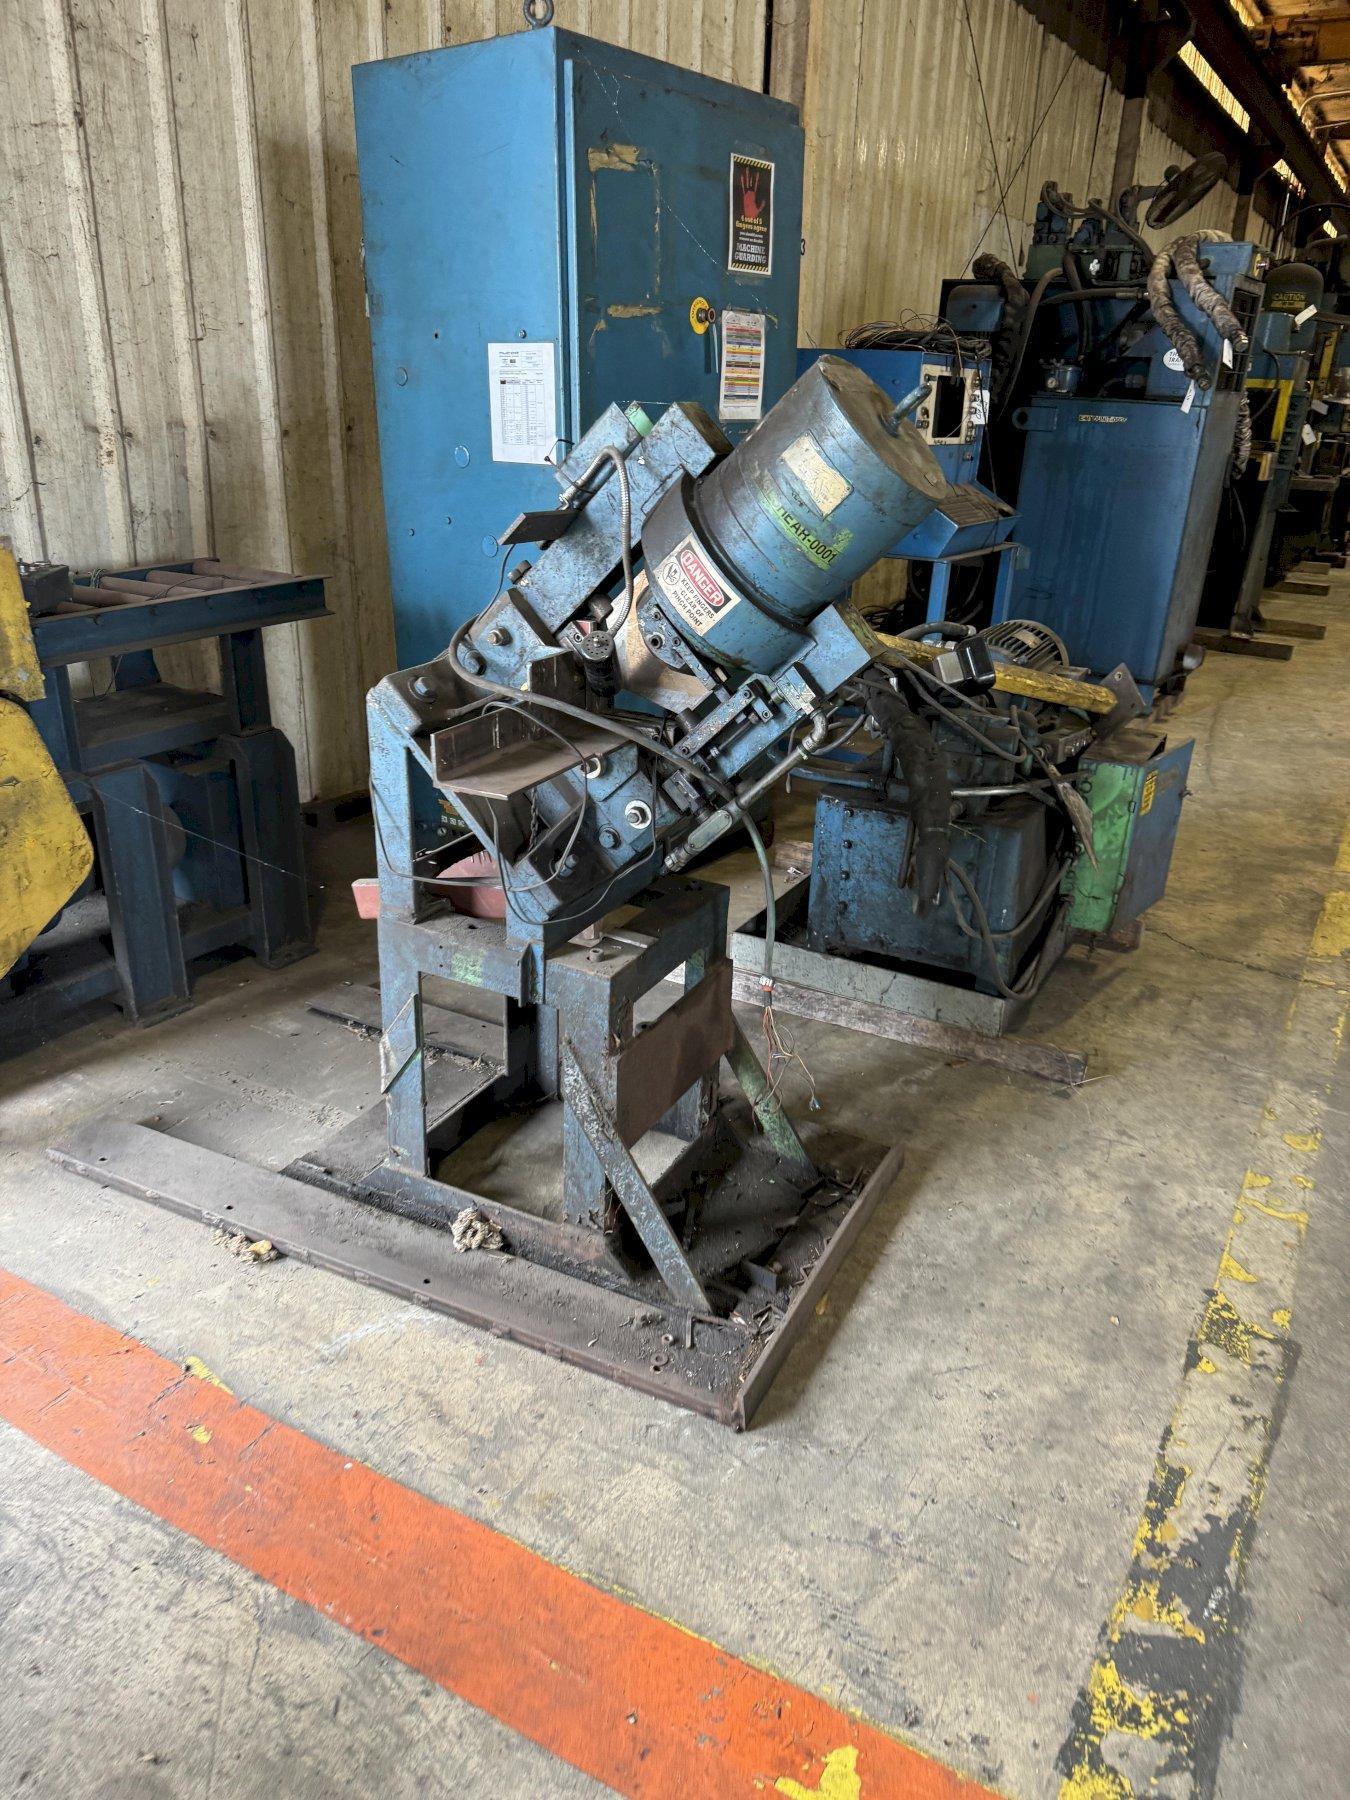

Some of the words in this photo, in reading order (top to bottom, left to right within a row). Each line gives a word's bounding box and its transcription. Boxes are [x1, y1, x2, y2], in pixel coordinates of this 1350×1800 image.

[734, 252, 767, 264] GUARDING
[736, 243, 766, 254] MACHINE
[683, 554, 722, 605] DANGER
[672, 590, 687, 612] PINCH
[686, 610, 703, 627] POINT
[680, 590, 697, 611] CLEAR
[695, 609, 705, 618] OF
[681, 578, 695, 596] KEEP
[693, 594, 715, 619] FINGERS
